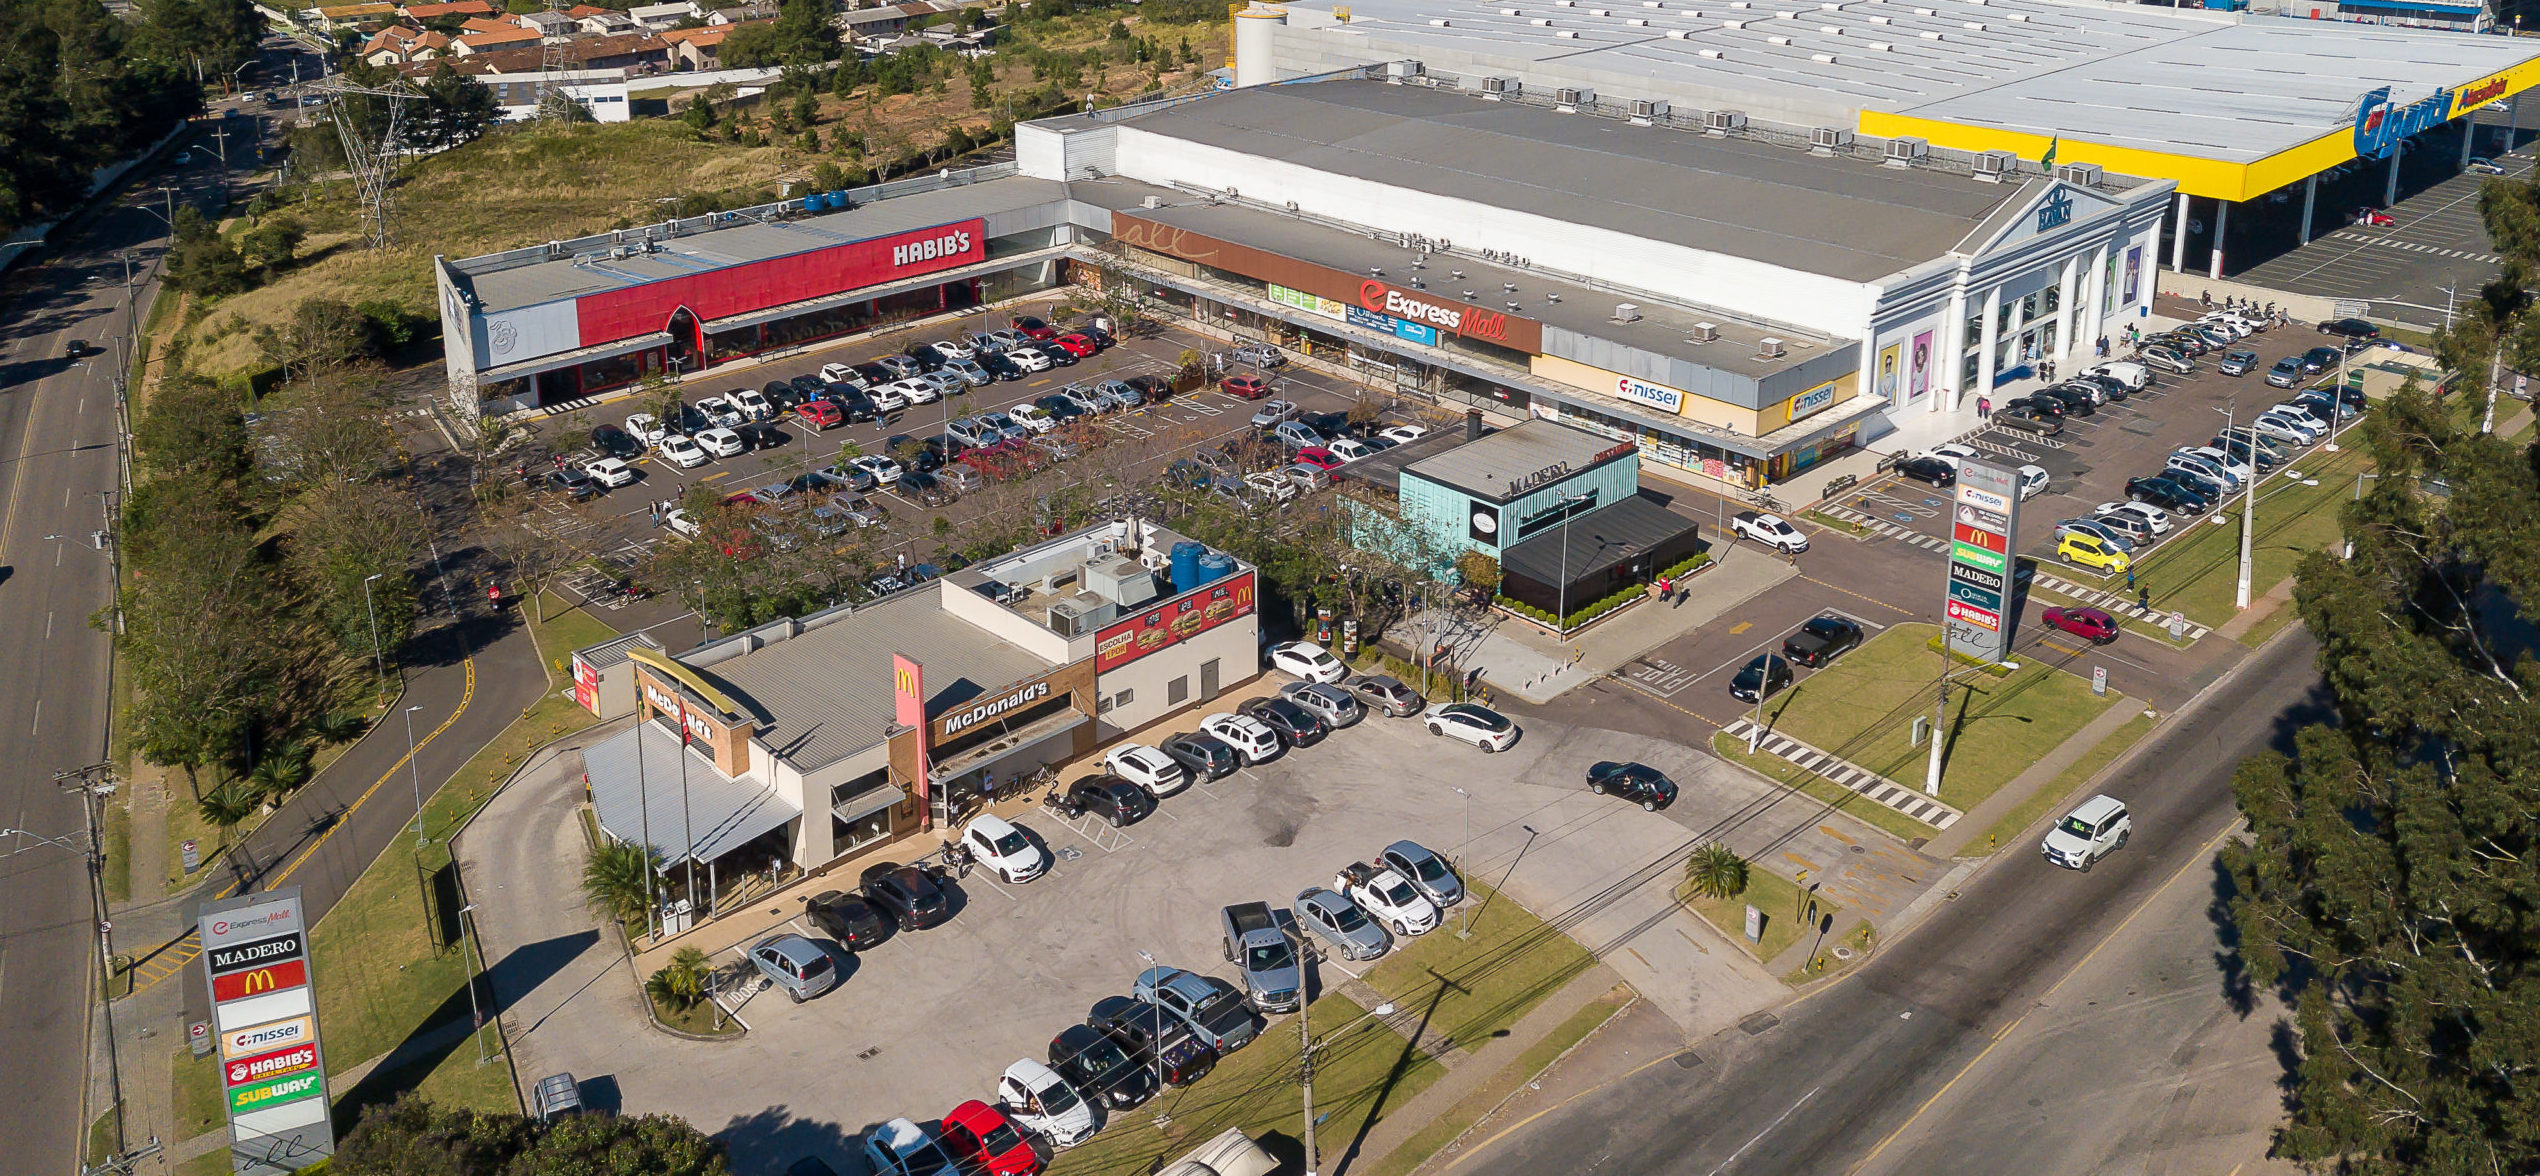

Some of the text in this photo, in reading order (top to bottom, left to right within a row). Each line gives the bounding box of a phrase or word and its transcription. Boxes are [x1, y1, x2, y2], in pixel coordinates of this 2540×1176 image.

[2037, 199, 2073, 233] HAVAN
[894, 230, 969, 266] HABIB'S
[1386, 290, 1461, 329] Express
[1457, 306, 1508, 341] Mall
[1634, 384, 1678, 406] nissei
[1803, 386, 1833, 412] nissei
[1510, 461, 1570, 496] MADERO
[1956, 547, 2002, 568] SUBWAY
[1953, 565, 2001, 588] MADERO
[1961, 606, 1998, 627] HABIB'S
[1099, 633, 1132, 652] ESCOLHA
[1111, 645, 1126, 657] POR
[646, 684, 713, 740] McDoald's
[945, 681, 1048, 735] McDonald's
[230, 916, 268, 930] Express
[266, 909, 291, 925] Mall
[215, 939, 296, 967] MADERO
[252, 1025, 299, 1044] nissei
[250, 1049, 313, 1075] HABIB'S
[235, 1075, 317, 1106] SUBWAY
